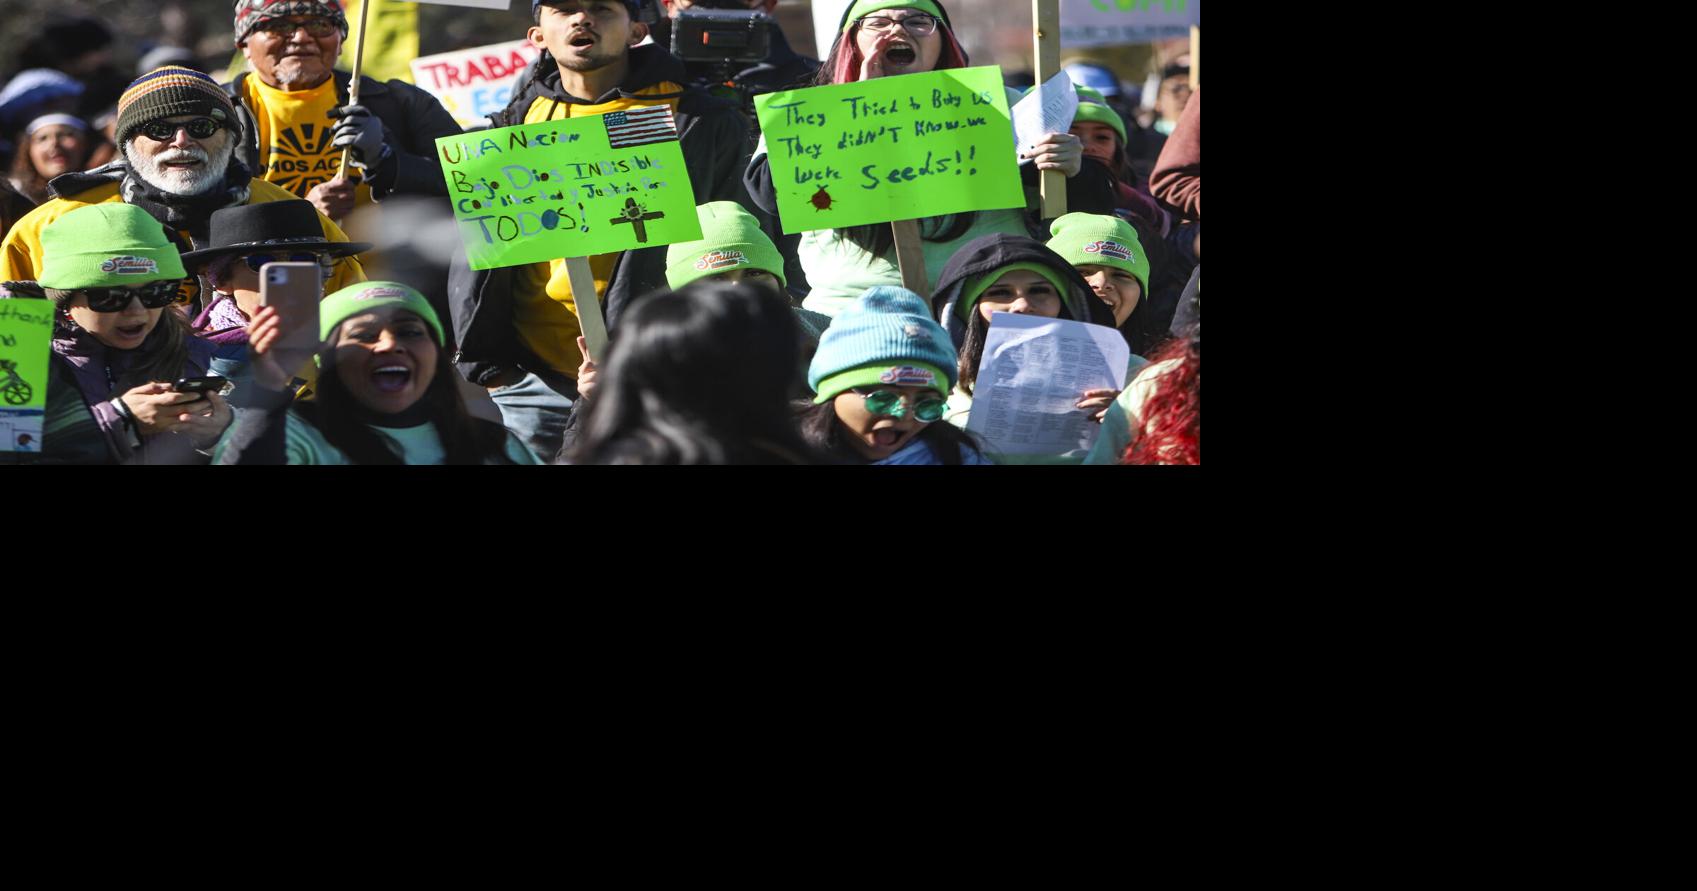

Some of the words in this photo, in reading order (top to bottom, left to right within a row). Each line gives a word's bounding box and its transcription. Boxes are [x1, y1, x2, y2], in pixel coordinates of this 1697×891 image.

[768, 101, 826, 127] They
[842, 96, 898, 119] Tried
[909, 96, 921, 110] to
[777, 134, 823, 159] They
[451, 170, 500, 200] Bajo
[501, 164, 564, 190] Dios
